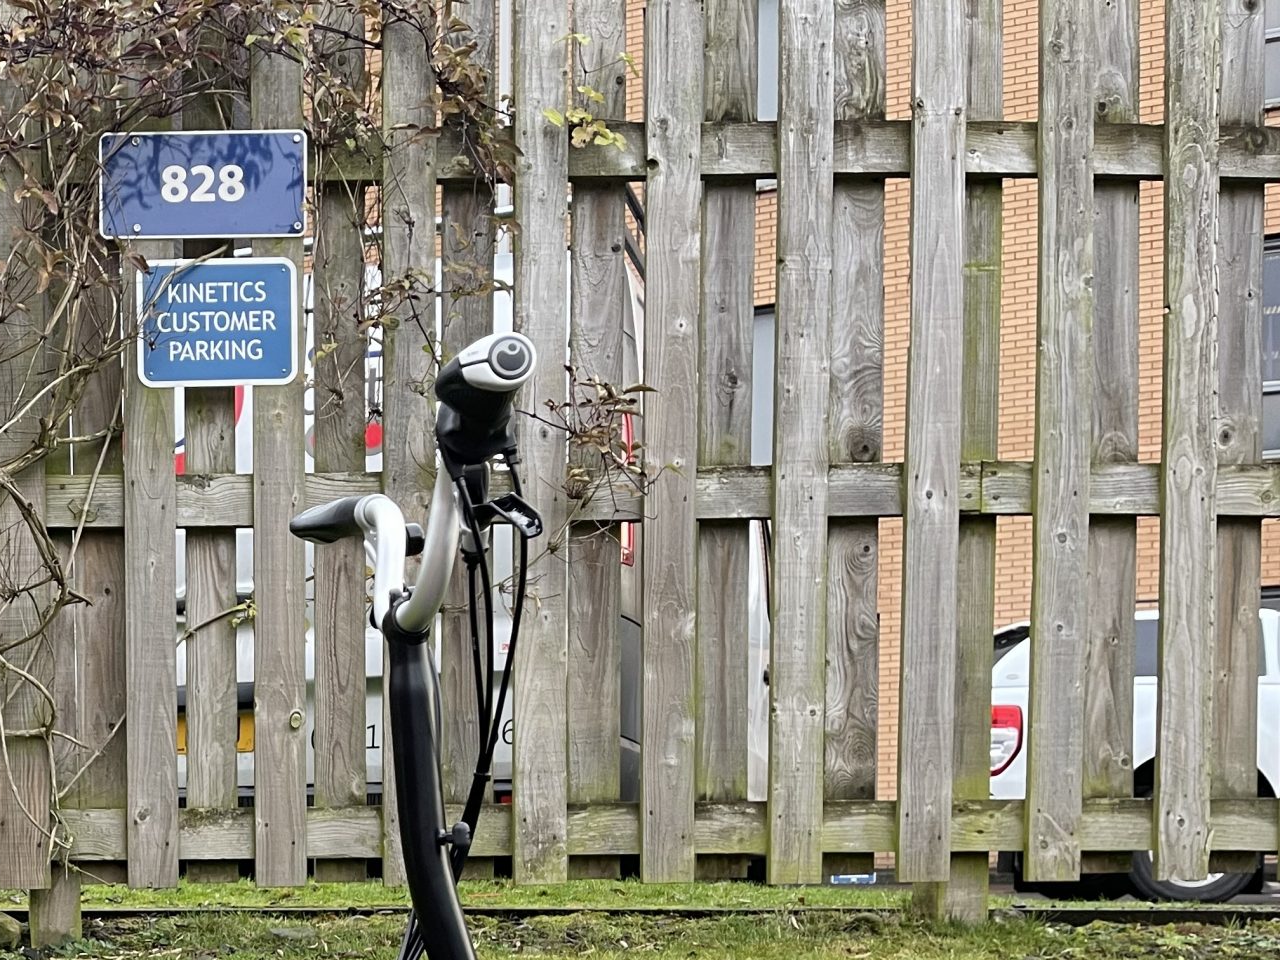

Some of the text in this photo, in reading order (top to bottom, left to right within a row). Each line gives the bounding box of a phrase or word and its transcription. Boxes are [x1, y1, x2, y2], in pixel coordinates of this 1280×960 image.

[161, 165, 245, 202] 828
[167, 282, 267, 304] KINETICS
[157, 309, 276, 333] CUSTOMER
[169, 340, 263, 362] PARKING
